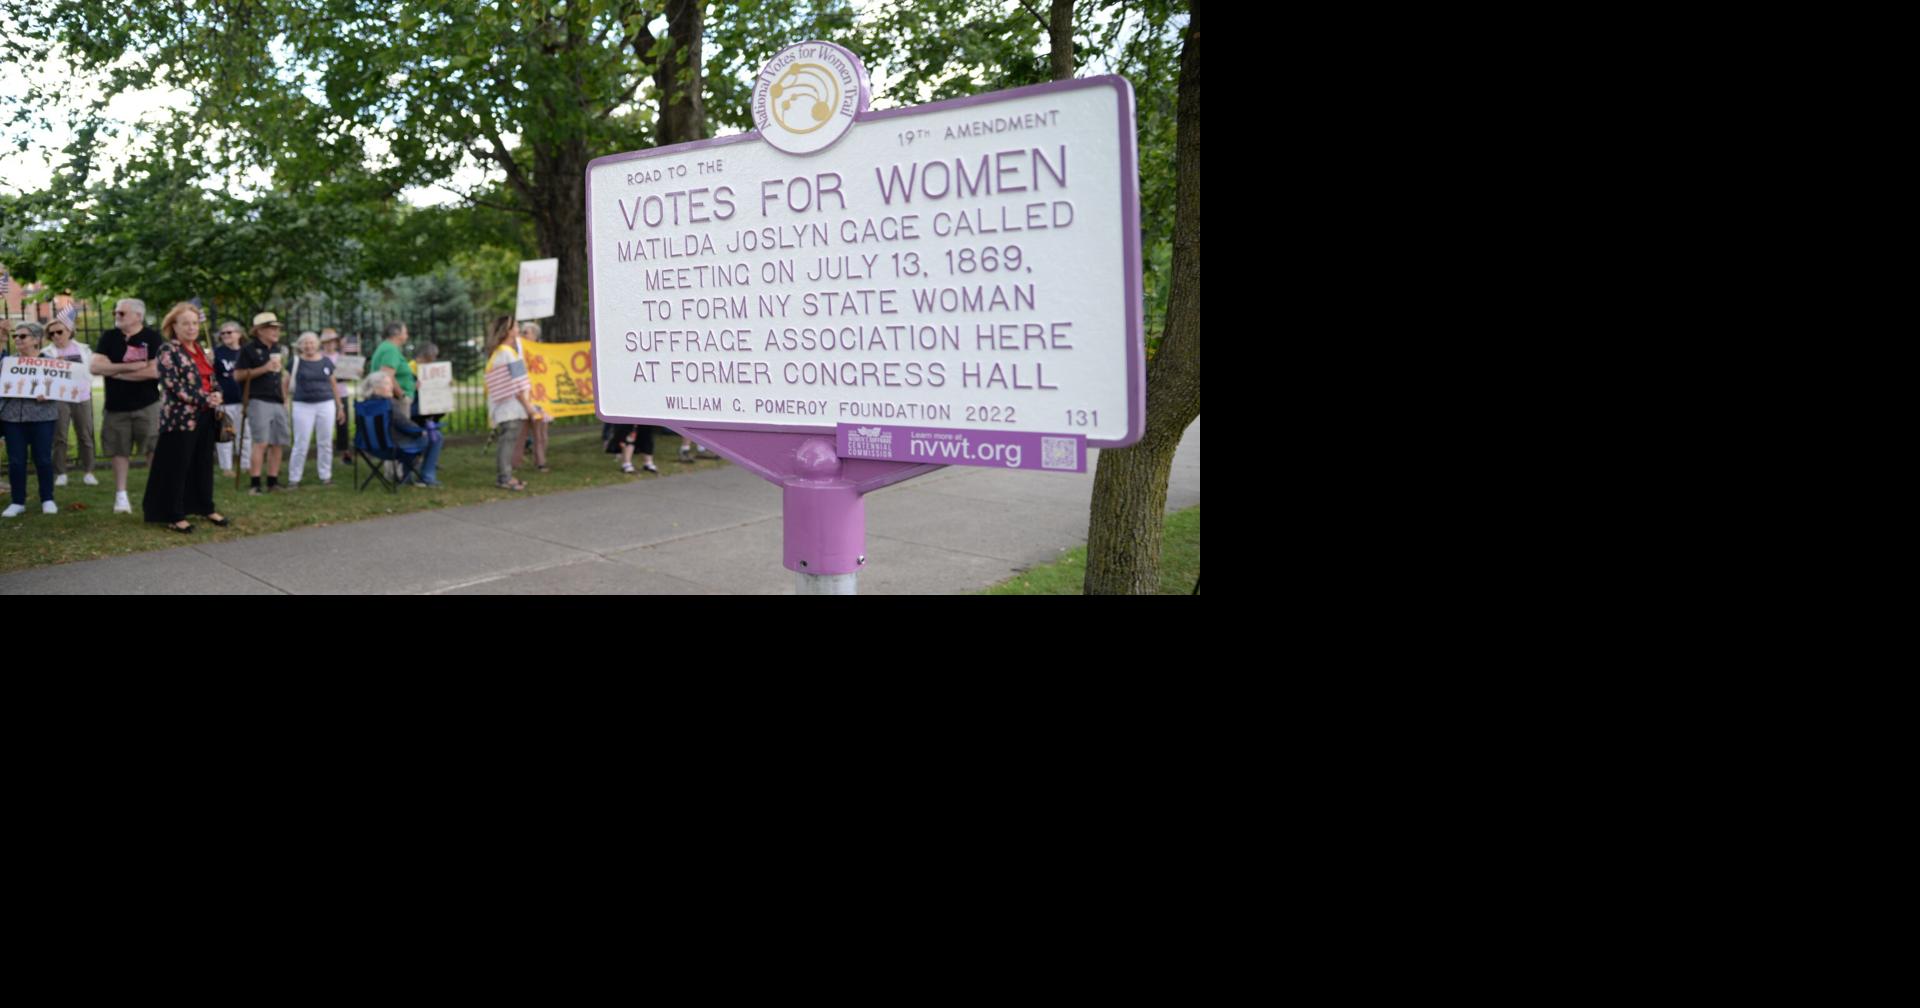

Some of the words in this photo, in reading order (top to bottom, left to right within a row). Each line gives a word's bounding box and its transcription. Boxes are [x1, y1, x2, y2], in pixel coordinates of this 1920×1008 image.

[755, 77, 771, 129] National
[765, 52, 796, 77] Votes
[799, 45, 816, 58] for
[818, 45, 853, 85] Women
[840, 85, 858, 118] Trail
[944, 109, 1060, 141] AMENDMENT
[618, 186, 735, 230] VOTES
[761, 172, 846, 217] FOR
[876, 144, 1067, 205] WOMEN
[627, 169, 662, 185] ROAD
[667, 164, 687, 179] TO
[697, 159, 723, 174] THE
[618, 233, 715, 263] MATILDA
[726, 222, 829, 253] JOSLYN
[840, 215, 919, 243] GAGE
[933, 200, 1074, 237] CALLED
[645, 263, 749, 291] MEETING
[761, 259, 794, 284] ON
[807, 254, 878, 281] JULY
[945, 245, 1032, 275] 1869,
[642, 300, 671, 321] TO
[682, 295, 748, 320] FORM
[759, 294, 791, 318] NY
[802, 289, 898, 316] STATE
[912, 283, 1035, 313] WOMAN
[625, 330, 752, 352] SUFFRAGE
[764, 325, 959, 351] ASSOCIATION
[976, 322, 1073, 350] HERE
[10, 366, 37, 375] OUR
[43, 368, 72, 379] VOTE
[18, 357, 72, 369] PROTECT
[633, 361, 660, 383] AT
[671, 361, 772, 384] FORMER
[783, 362, 946, 387] CONGRESS
[962, 362, 1058, 390] HALL
[665, 396, 722, 412] WILLIAM
[755, 399, 827, 416] POMEROY
[839, 402, 951, 421] FOUNDATION
[965, 406, 1017, 423] 2022
[1065, 409, 1099, 428] 131
[910, 438, 1022, 467] nvwt.org
